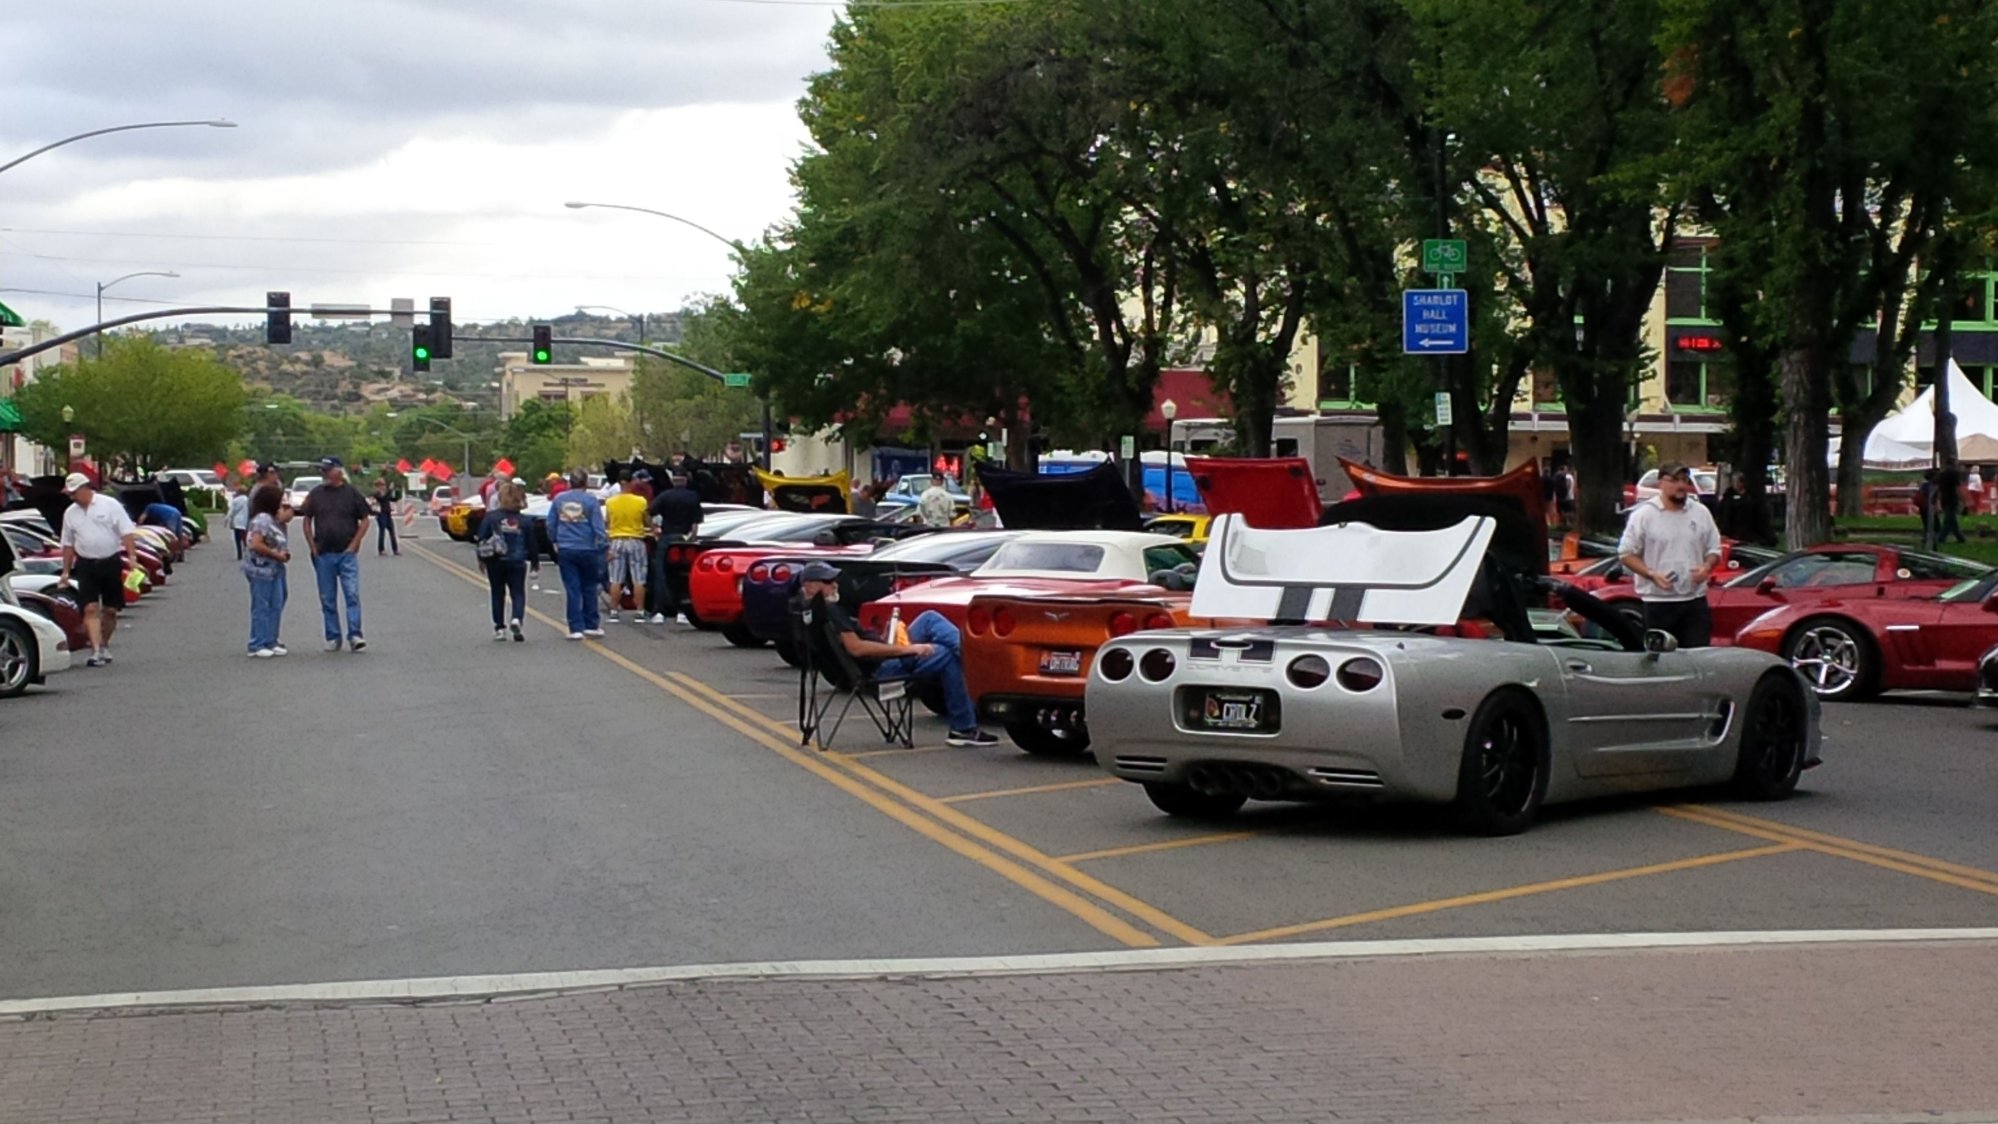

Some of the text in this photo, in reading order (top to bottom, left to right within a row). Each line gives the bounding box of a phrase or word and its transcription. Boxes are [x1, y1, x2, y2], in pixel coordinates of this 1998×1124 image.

[1413, 294, 1458, 306] SHARLOT
[1422, 309, 1448, 320] HALL
[1415, 323, 1457, 334] MUSEUM
